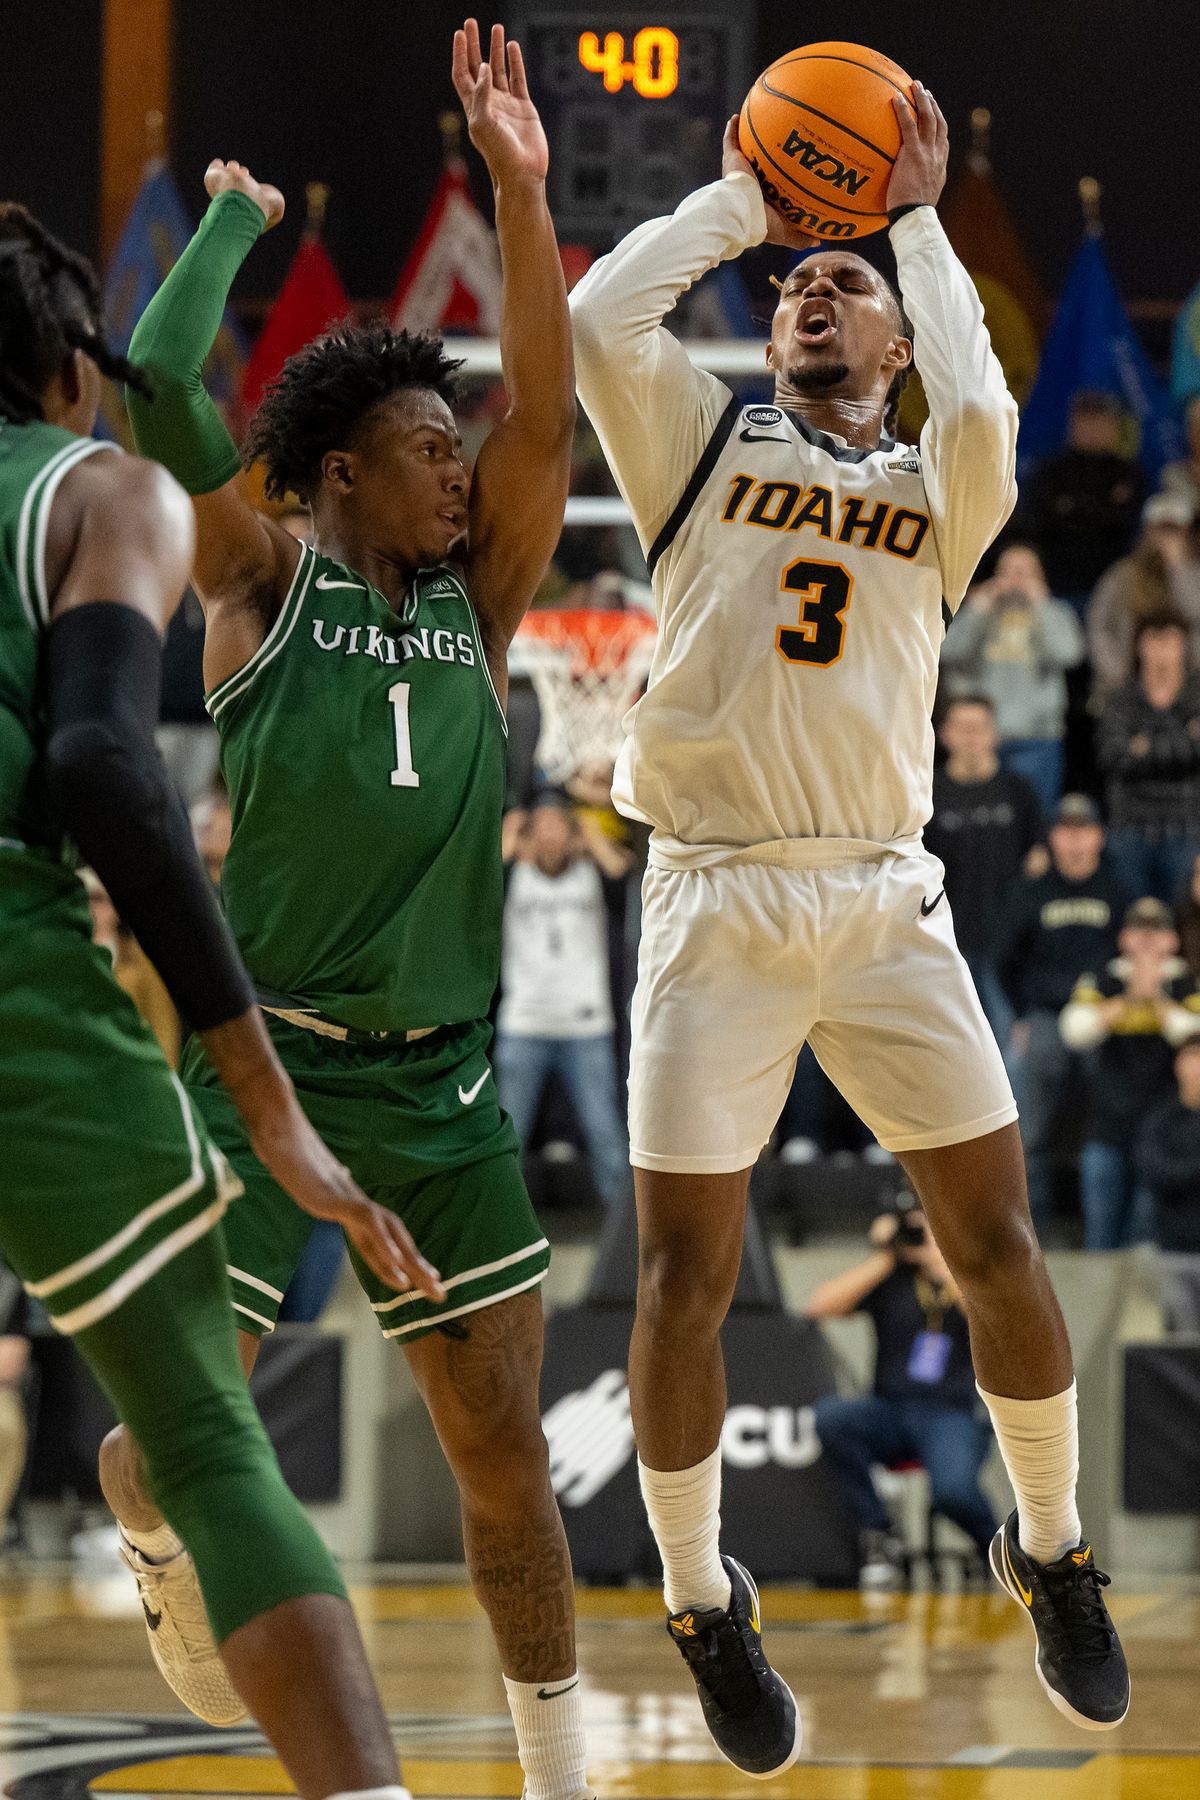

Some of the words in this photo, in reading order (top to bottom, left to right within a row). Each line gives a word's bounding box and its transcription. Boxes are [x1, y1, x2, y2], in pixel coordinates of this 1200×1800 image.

[781, 128, 871, 195] NCAA
[721, 473, 932, 561] IDAHO
[312, 619, 475, 667] VIKINGS
[775, 557, 854, 669] 3
[388, 682, 420, 788] 1
